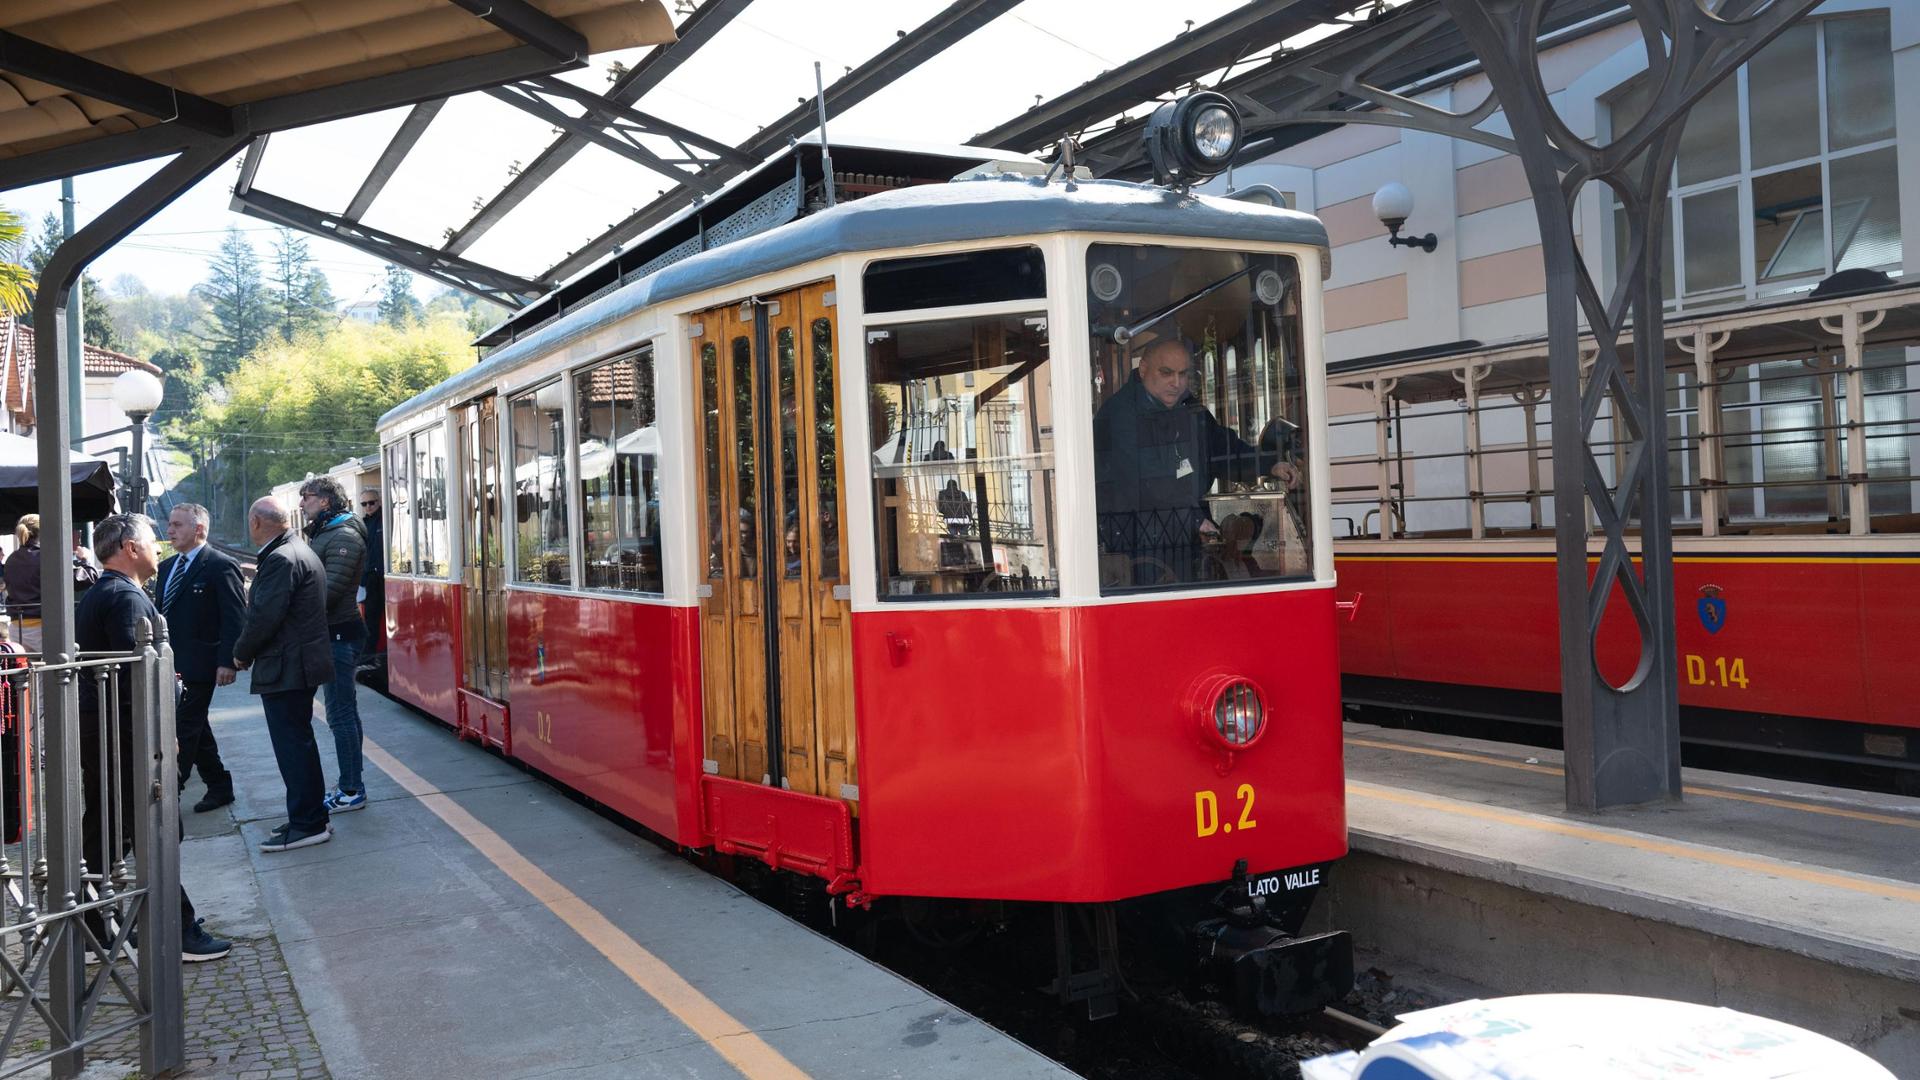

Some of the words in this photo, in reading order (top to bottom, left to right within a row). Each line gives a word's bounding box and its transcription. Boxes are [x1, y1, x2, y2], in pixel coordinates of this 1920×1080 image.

[1686, 655, 1749, 689] D.14
[537, 711, 552, 744] D.2
[1195, 783, 1257, 838] D.2
[1247, 876, 1280, 897] LATO
[1284, 868, 1320, 890] VALLE
